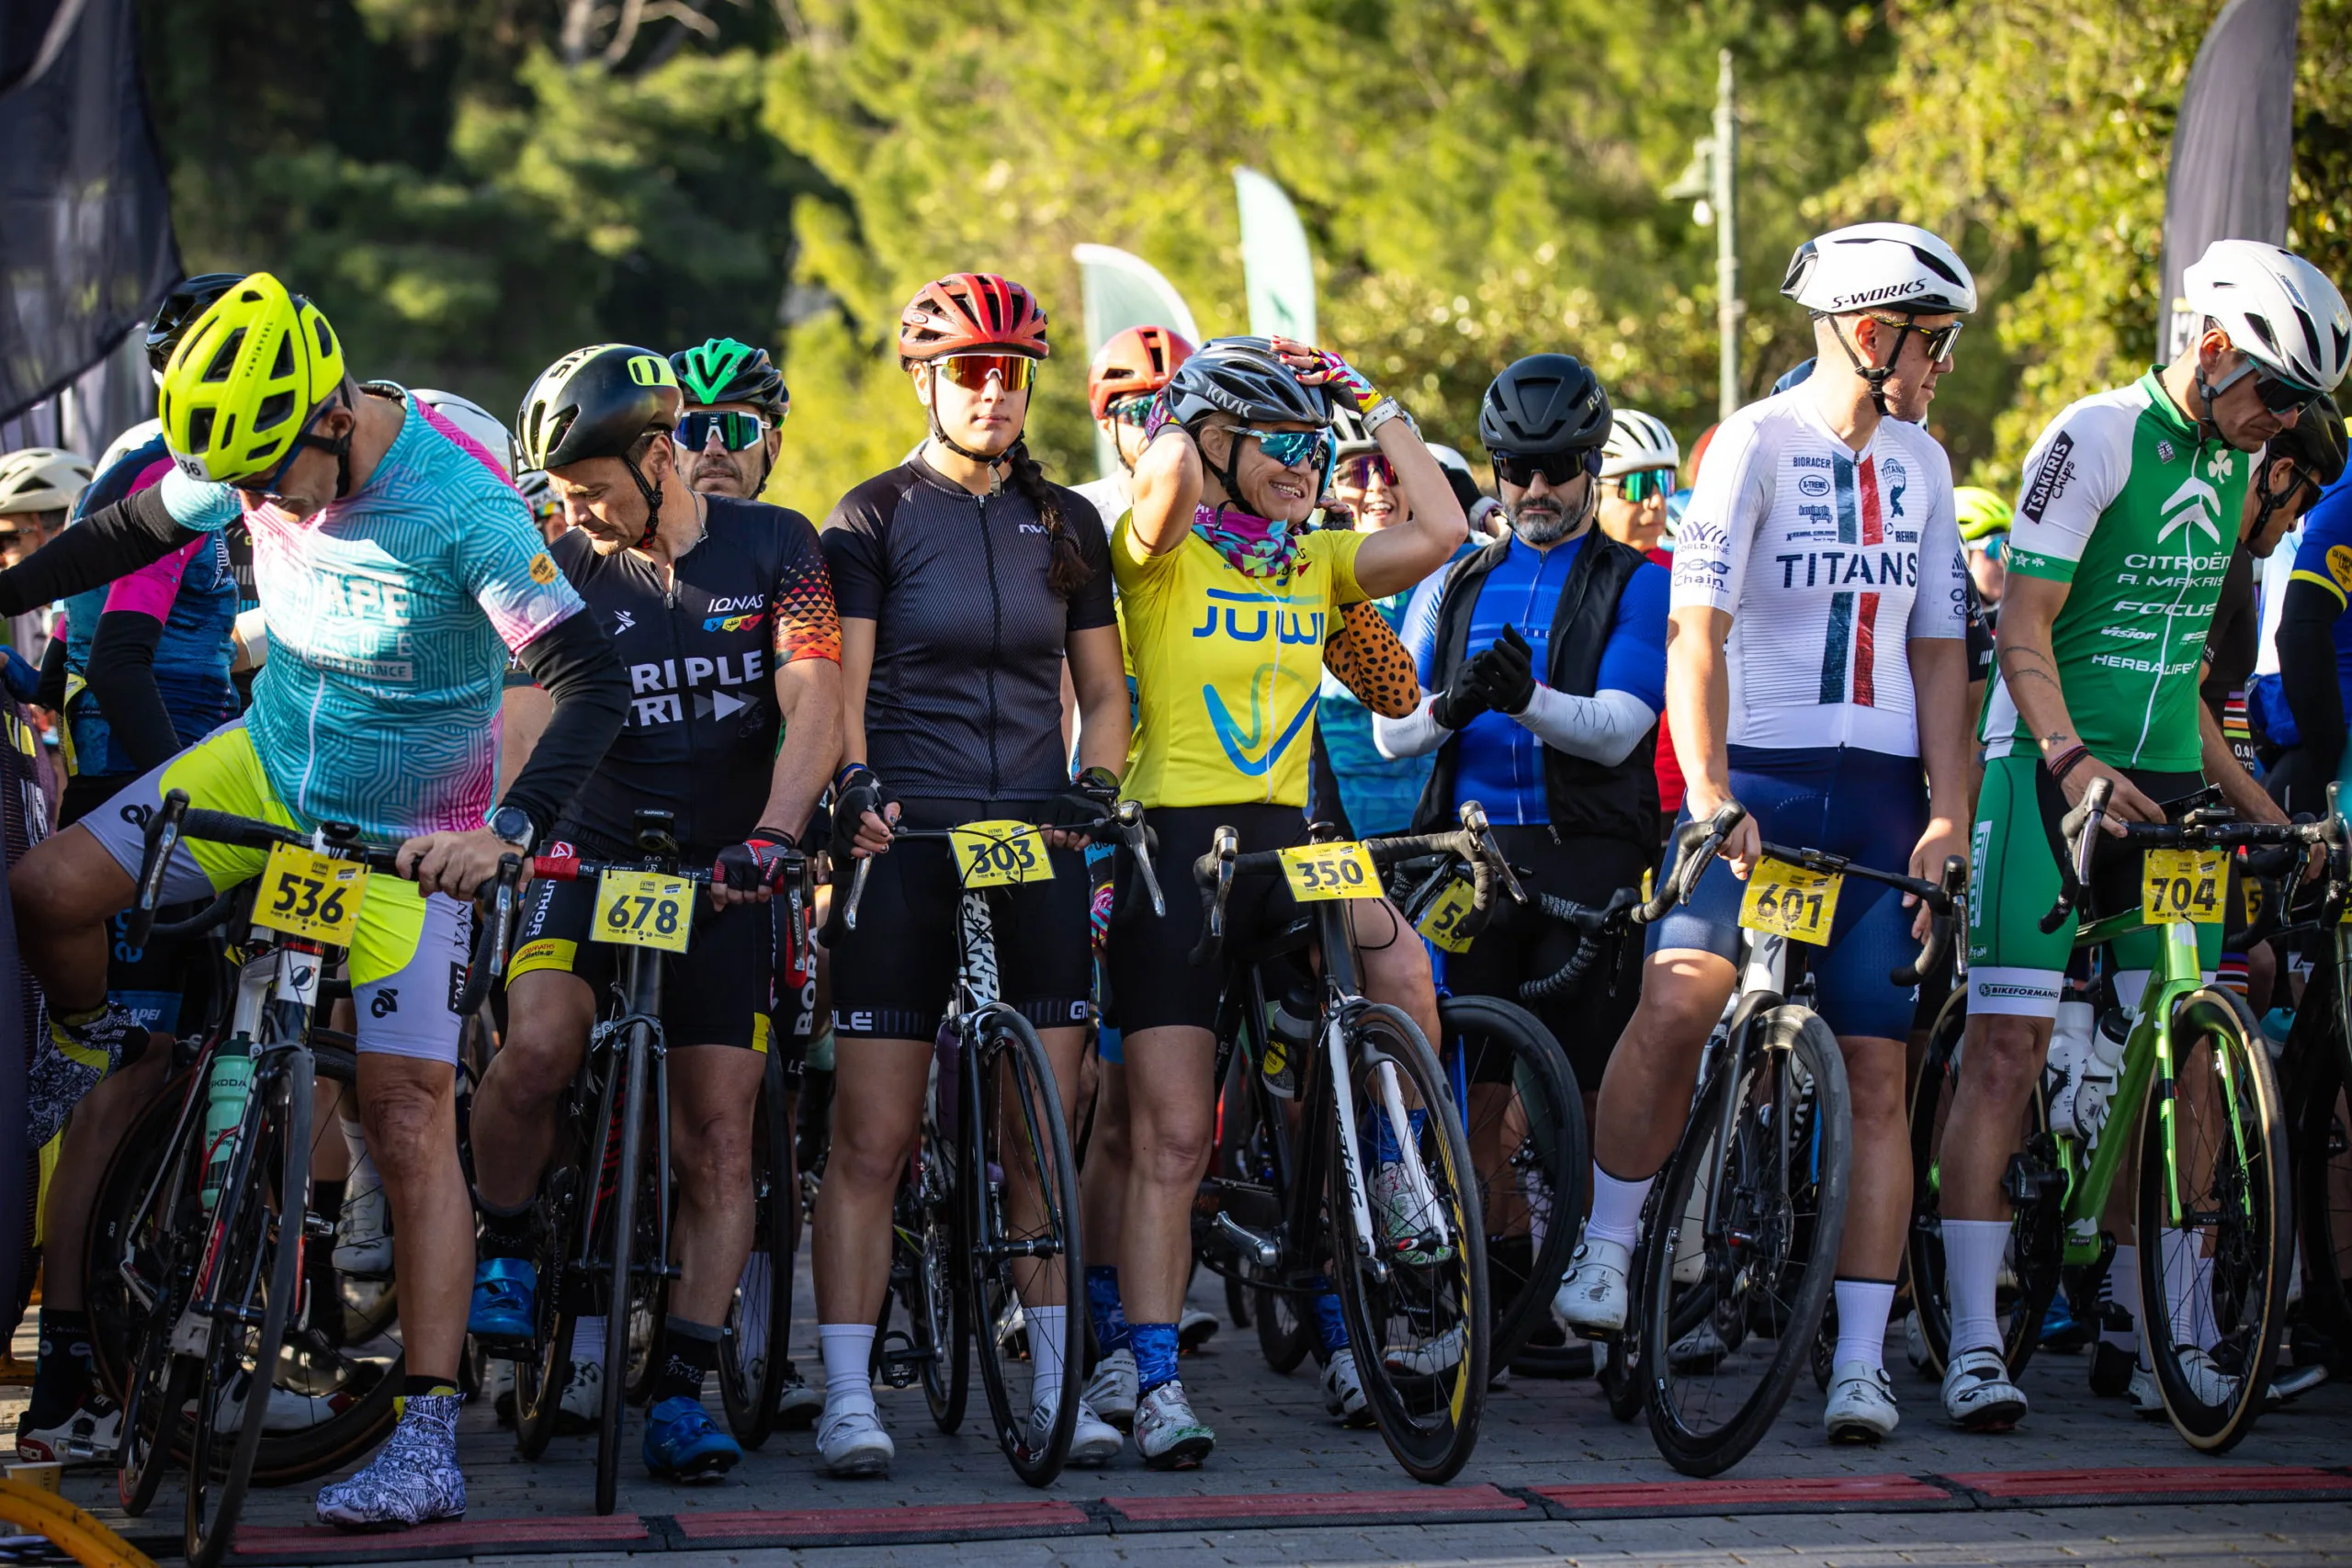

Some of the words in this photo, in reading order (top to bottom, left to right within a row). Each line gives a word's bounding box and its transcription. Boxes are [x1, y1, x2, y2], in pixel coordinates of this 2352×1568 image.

[1831, 278, 1928, 310] S-WORKS
[1204, 384, 1253, 418] KASK
[179, 458, 202, 477] 36
[1792, 457, 1831, 468] BIORACER
[1881, 465, 1906, 476] TITANS
[2026, 442, 2068, 513] TSAKIRIS
[2052, 460, 2077, 500] Chips
[1674, 573, 1724, 588] Chain
[1776, 551, 1917, 589] TITANS
[2117, 573, 2140, 585] A.
[2112, 601, 2217, 617] FOCUS
[345, 660, 407, 678] FRANCE
[625, 649, 764, 694] RIPLE
[967, 839, 1035, 874] 303
[1296, 859, 1364, 888] 350
[273, 872, 347, 924] 536
[530, 879, 557, 937] UTHOR
[1757, 883, 1824, 929] 601
[2151, 877, 2216, 912] 704
[454, 901, 469, 948] VAN
[606, 895, 679, 934] 678
[792, 897, 803, 947] ULTEGRA
[794, 926, 819, 1035] BORA
